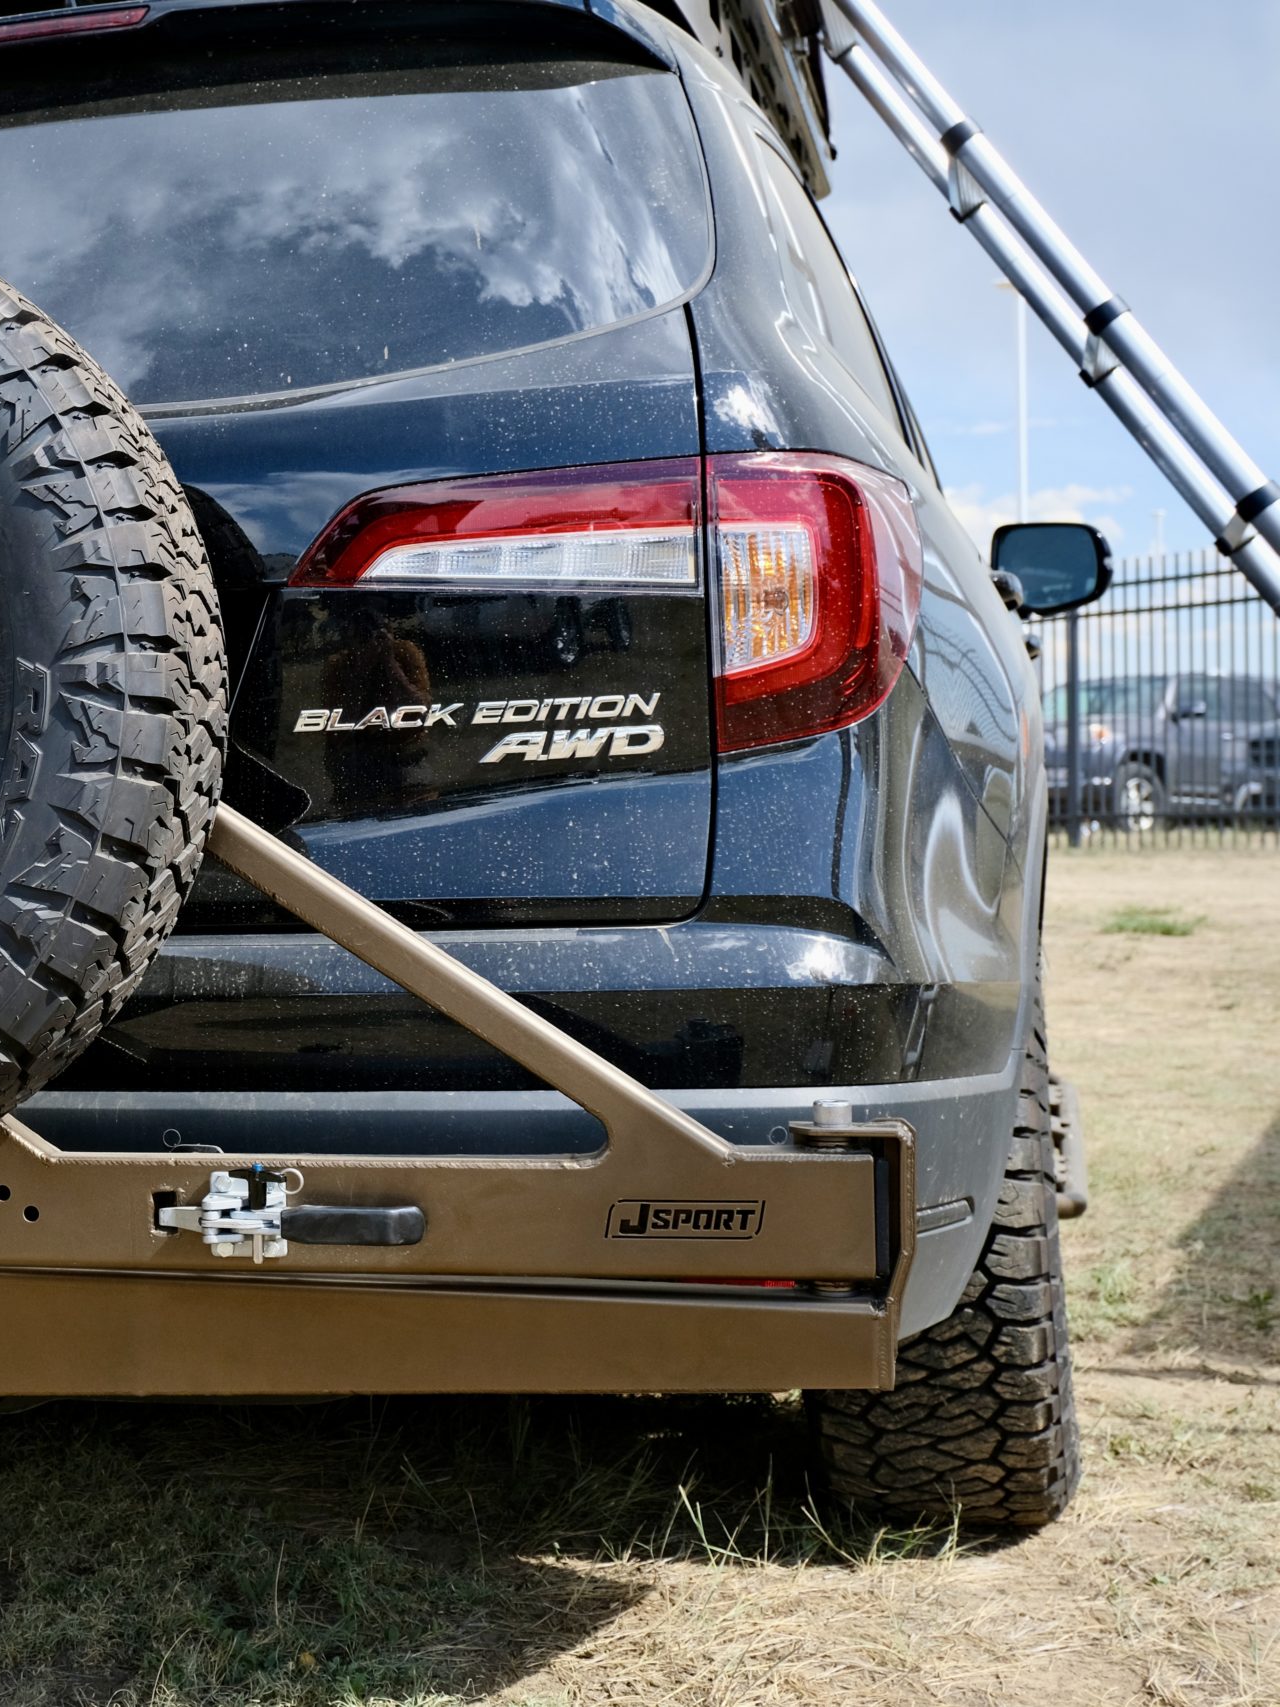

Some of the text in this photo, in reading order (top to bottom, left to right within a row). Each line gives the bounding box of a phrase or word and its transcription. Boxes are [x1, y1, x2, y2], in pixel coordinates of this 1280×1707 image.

[293, 692, 661, 732] BLACK EDITION
[479, 724, 665, 763] AWD
[619, 1203, 756, 1234] JSPORT
